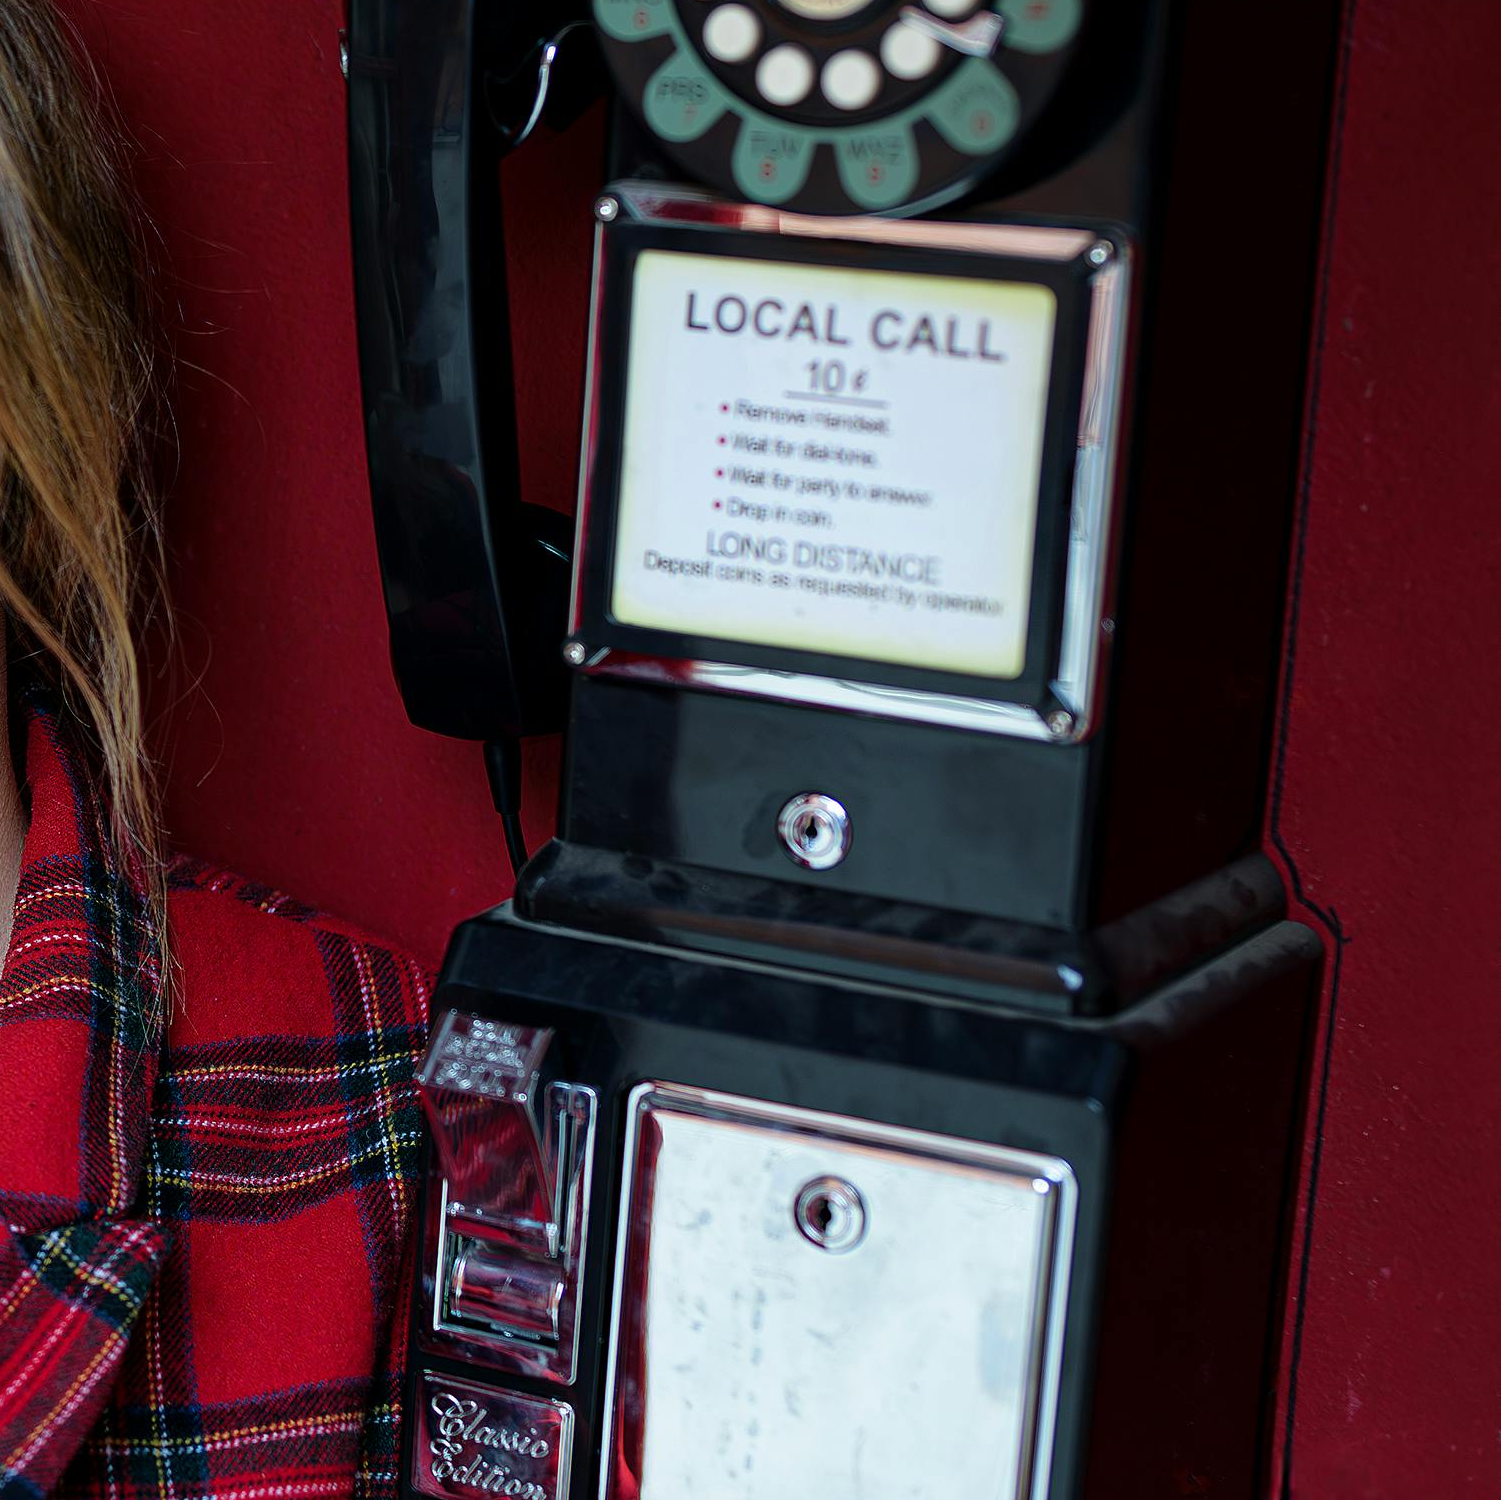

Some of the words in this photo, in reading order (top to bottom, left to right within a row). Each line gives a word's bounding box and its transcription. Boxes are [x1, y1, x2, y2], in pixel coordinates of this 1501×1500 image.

[684, 291, 852, 348] LOCAL
[869, 310, 1009, 364] CALL
[804, 358, 846, 394] 10
[735, 399, 806, 425] Remove
[732, 434, 769, 453] Wait
[774, 439, 795, 456] for
[728, 467, 766, 486] Wait
[772, 471, 791, 488] for
[797, 477, 841, 501] party
[844, 480, 862, 497] to
[726, 495, 768, 522] Drop
[774, 506, 787, 520] in
[642, 548, 714, 577] Deposit
[715, 563, 765, 586] coins
[769, 571, 791, 588] as
[705, 529, 788, 566] LONG
[793, 539, 944, 586] DISTANCE
[432, 1393, 549, 1458] Classic
